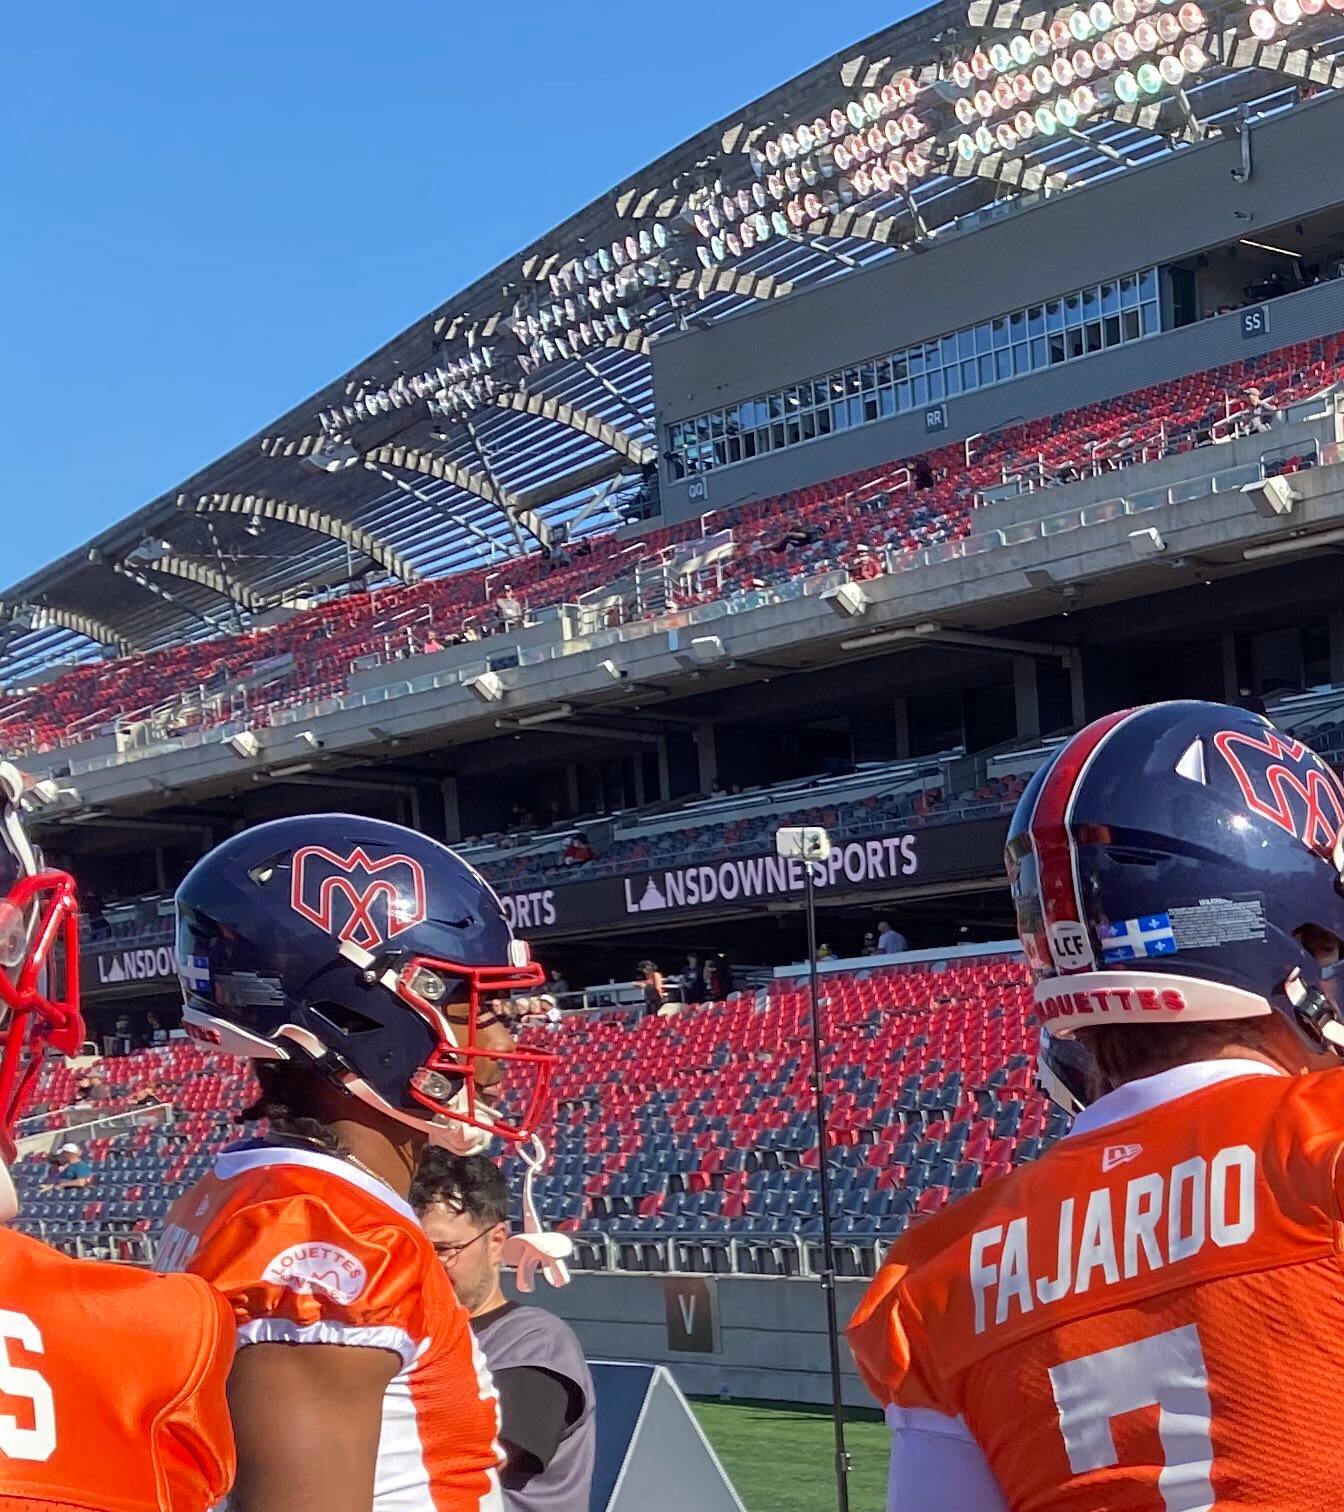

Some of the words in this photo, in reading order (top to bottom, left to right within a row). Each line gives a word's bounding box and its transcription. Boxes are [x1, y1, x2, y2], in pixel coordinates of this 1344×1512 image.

[1245, 313, 1261, 331] SS
[926, 410, 942, 427] RR
[812, 834, 918, 888] SPORTS
[503, 890, 557, 931] ORTS
[1053, 934, 1084, 958] LCF
[969, 1144, 1258, 1336] FAJARDO
[271, 1247, 361, 1279] LOUETTES
